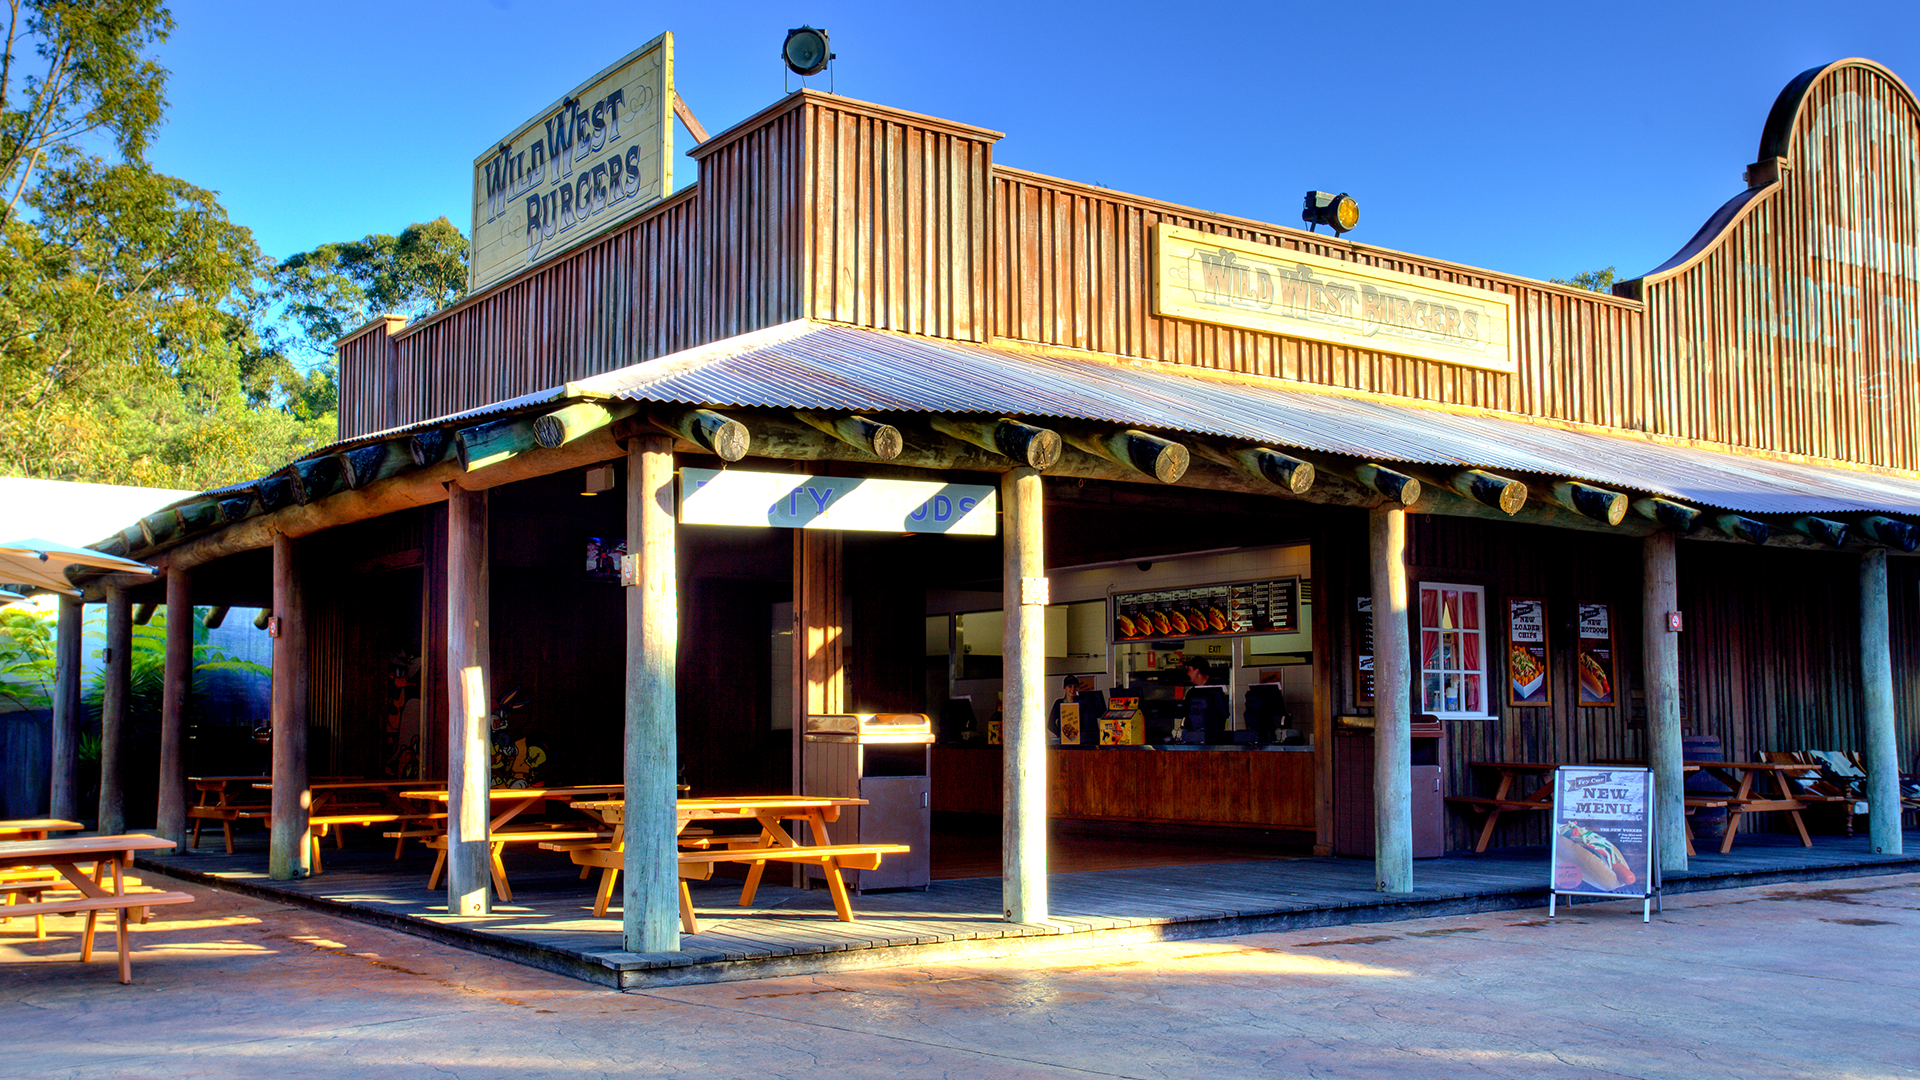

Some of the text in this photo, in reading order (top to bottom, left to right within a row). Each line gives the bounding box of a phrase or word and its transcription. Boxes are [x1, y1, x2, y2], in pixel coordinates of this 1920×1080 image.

[485, 88, 625, 224] WILD WEST
[525, 145, 641, 261] BURGERS
[1199, 249, 1479, 347] WILD WEST BURGERS
[1518, 631, 1537, 639] CHIPS
[1208, 645, 1222, 653] EXIT
[1583, 788, 1629, 799] NEW
[1576, 802, 1632, 814] MENU
